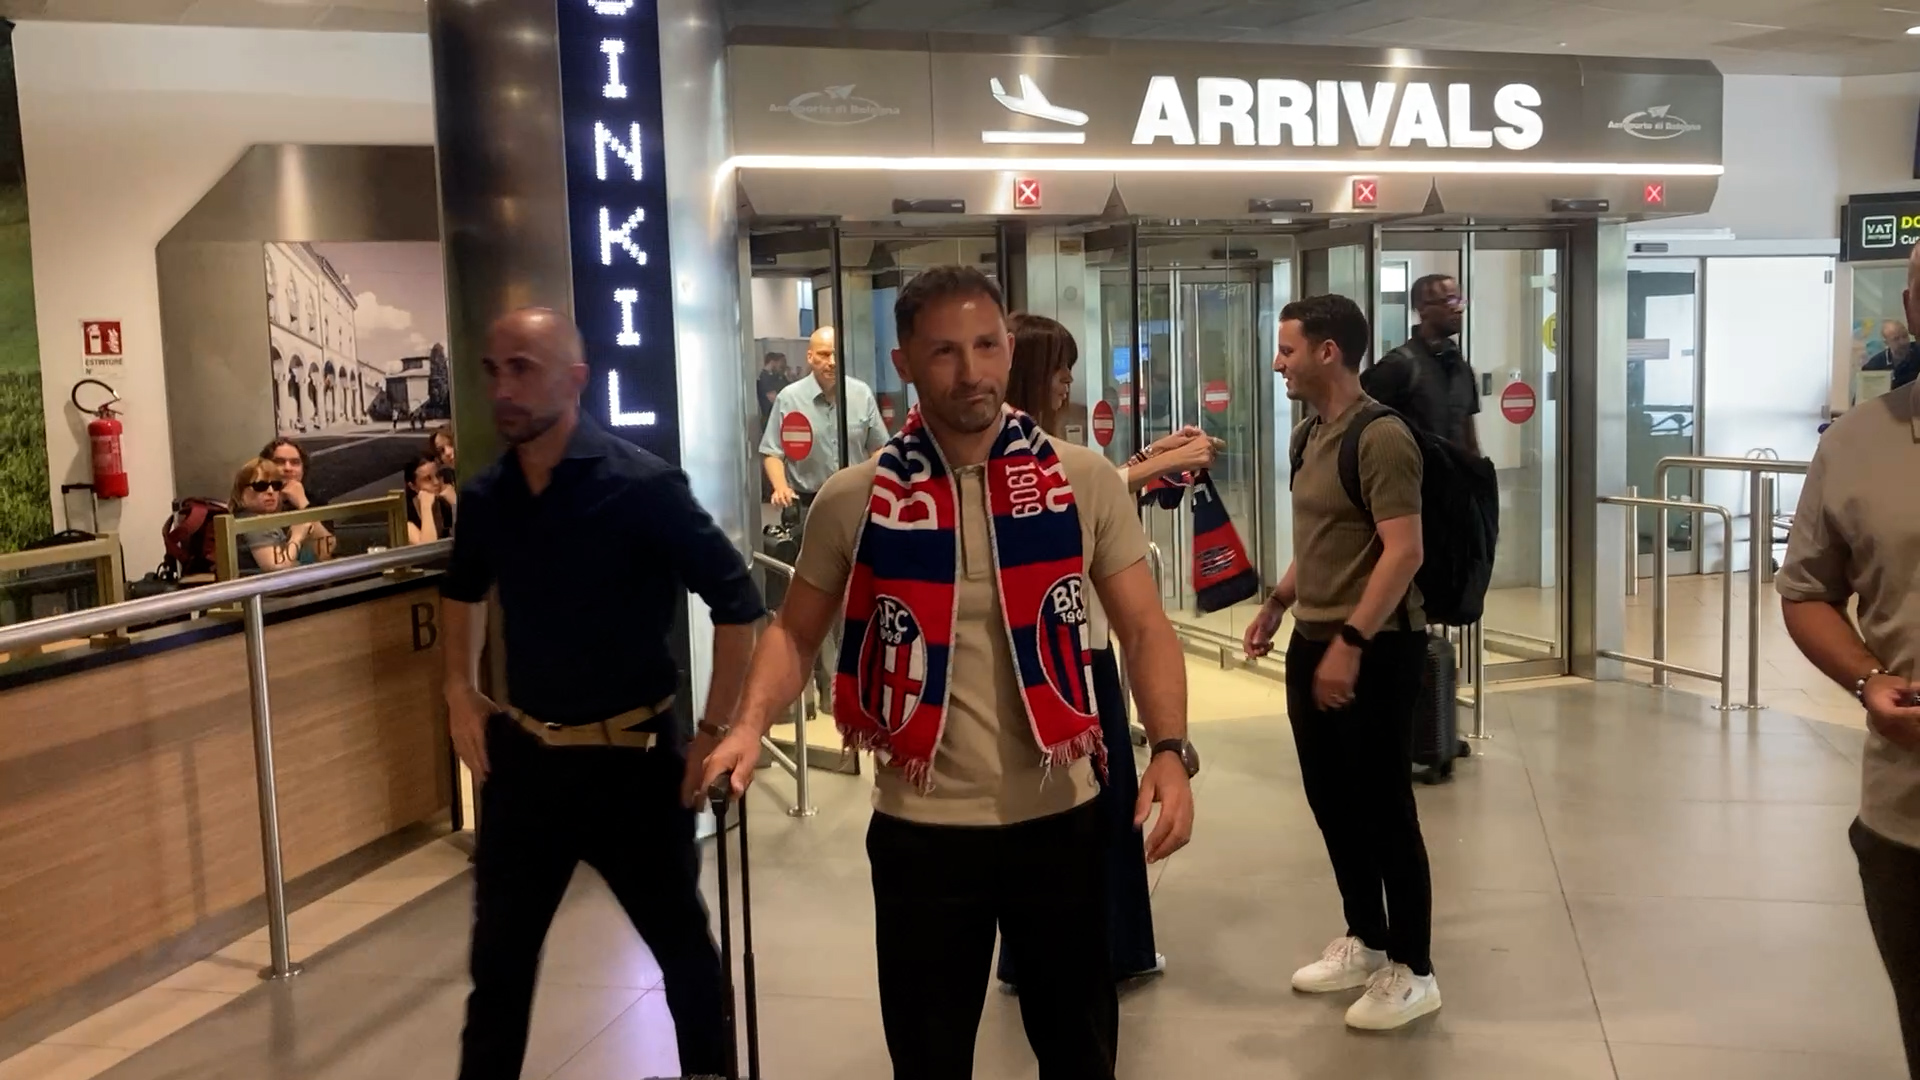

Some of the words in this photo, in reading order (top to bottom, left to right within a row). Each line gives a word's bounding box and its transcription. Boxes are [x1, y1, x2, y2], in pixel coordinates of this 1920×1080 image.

[1131, 75, 1543, 150] ARRIVALS
[1867, 223, 1892, 233] VAT
[1004, 461, 1043, 519] 1909
[1060, 608, 1087, 623] 190
